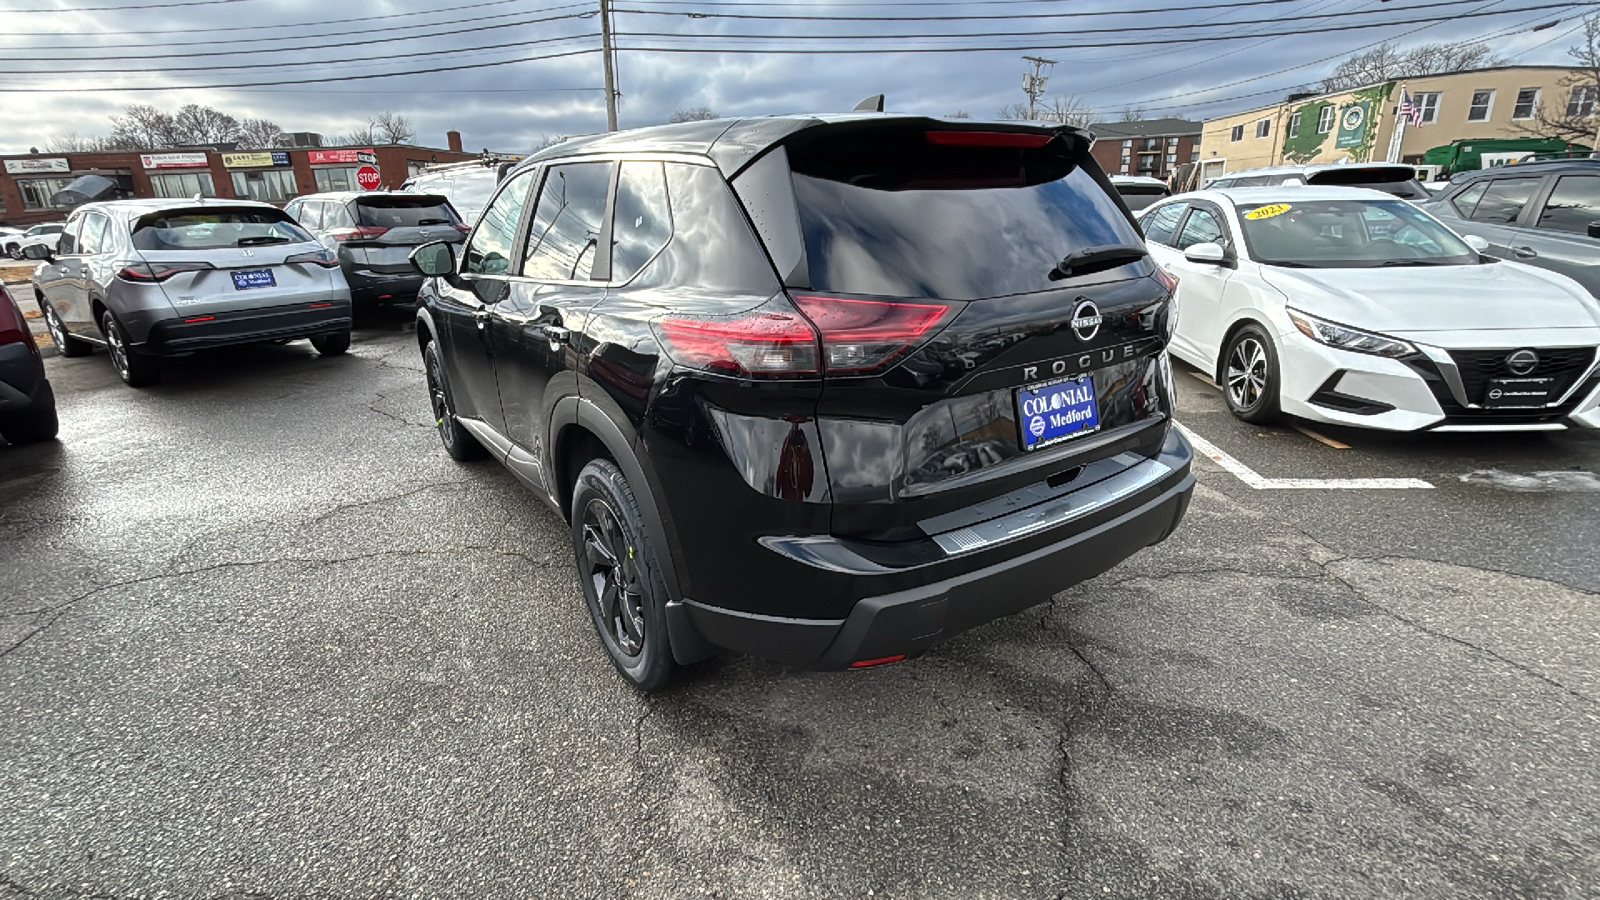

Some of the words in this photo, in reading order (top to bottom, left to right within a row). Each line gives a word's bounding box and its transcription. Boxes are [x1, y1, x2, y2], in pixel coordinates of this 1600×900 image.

[358, 173, 379, 183] STOP
[1254, 204, 1284, 218] 2023
[234, 272, 271, 280] COLONIAL
[1071, 315, 1102, 329] NISSAN
[1024, 345, 1134, 380] ROGUE
[1024, 386, 1093, 417] COLONIAL
[1050, 405, 1092, 429] Medford
